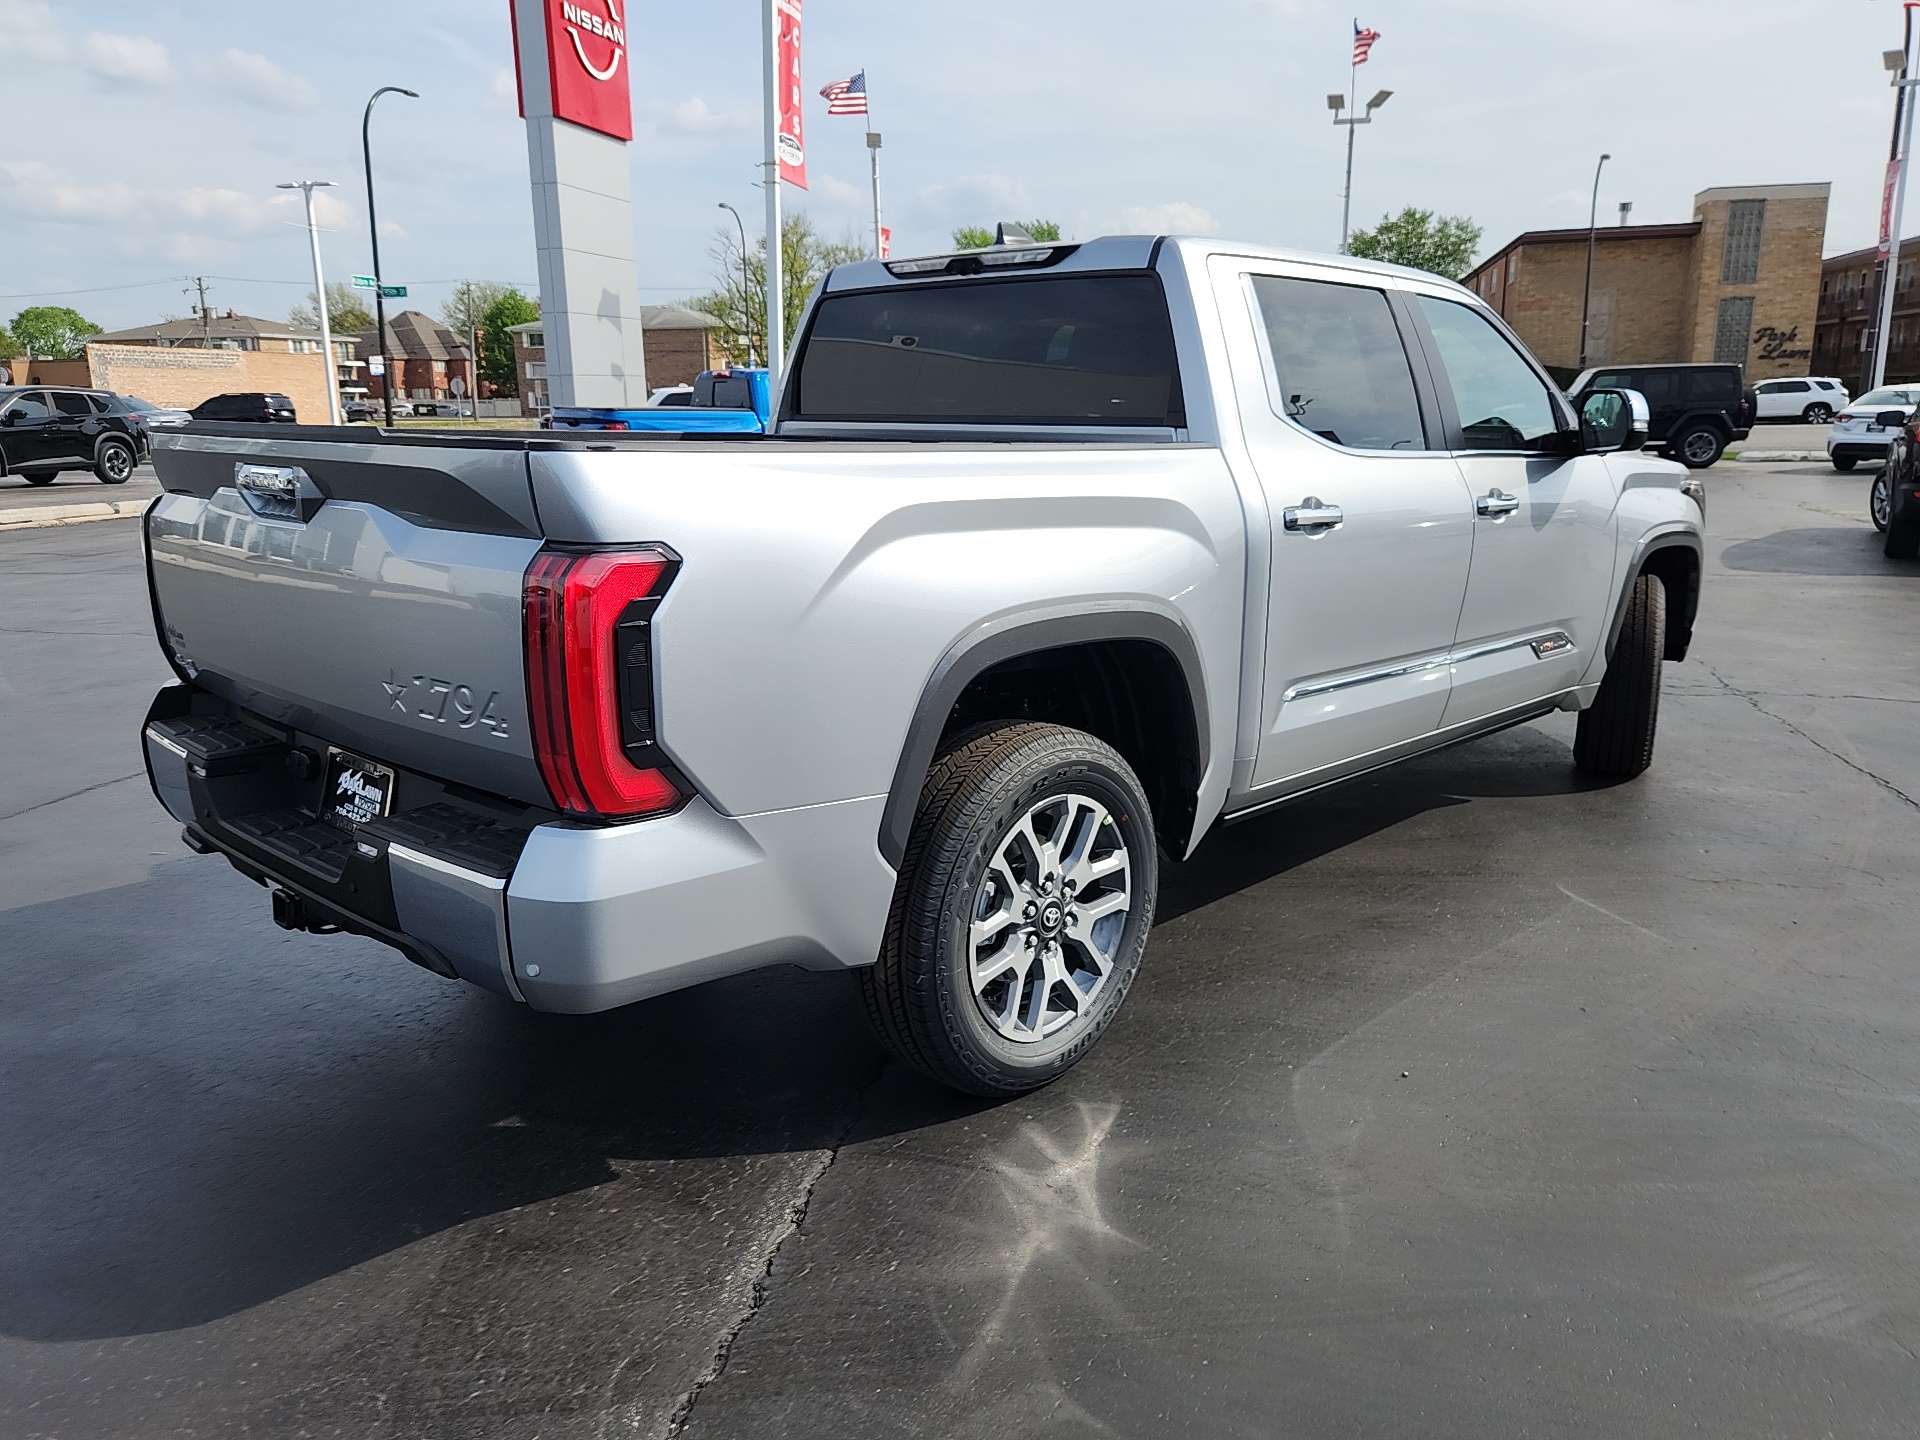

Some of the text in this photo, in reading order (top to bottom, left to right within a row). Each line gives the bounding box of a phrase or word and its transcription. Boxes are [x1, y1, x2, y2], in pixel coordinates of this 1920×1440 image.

[563, 1, 625, 46] NISSAN
[1753, 326, 1797, 344] Park
[412, 676, 508, 738] 1794
[1053, 887, 1154, 1070] BRIDGESTONE
